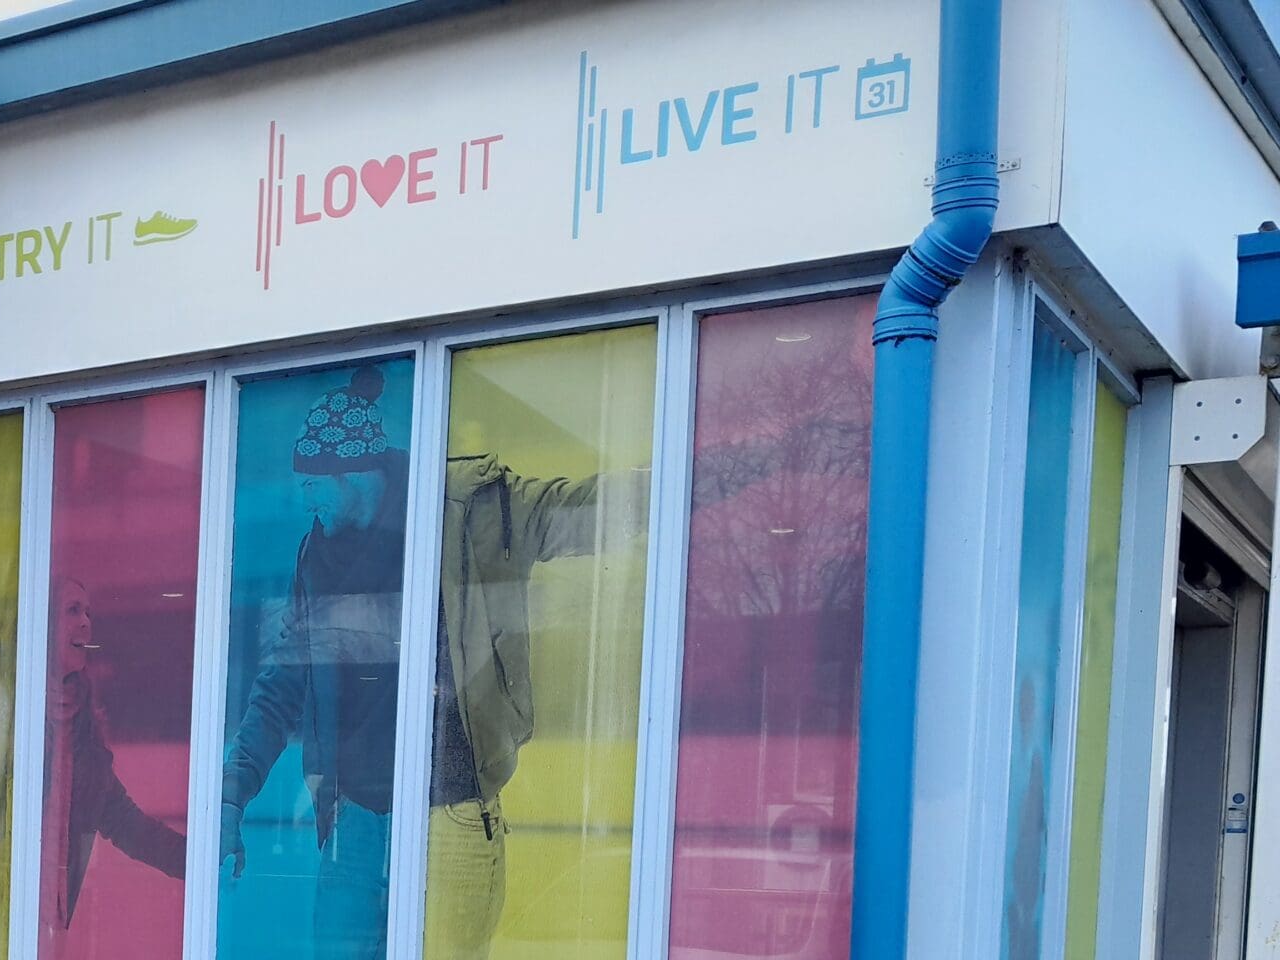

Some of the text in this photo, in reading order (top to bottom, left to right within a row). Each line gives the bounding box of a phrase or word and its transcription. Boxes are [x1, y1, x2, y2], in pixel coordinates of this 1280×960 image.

[619, 65, 841, 165] LIVE IT
[867, 79, 897, 110] 31
[459, 134, 504, 195] IT
[87, 211, 122, 264] IT
